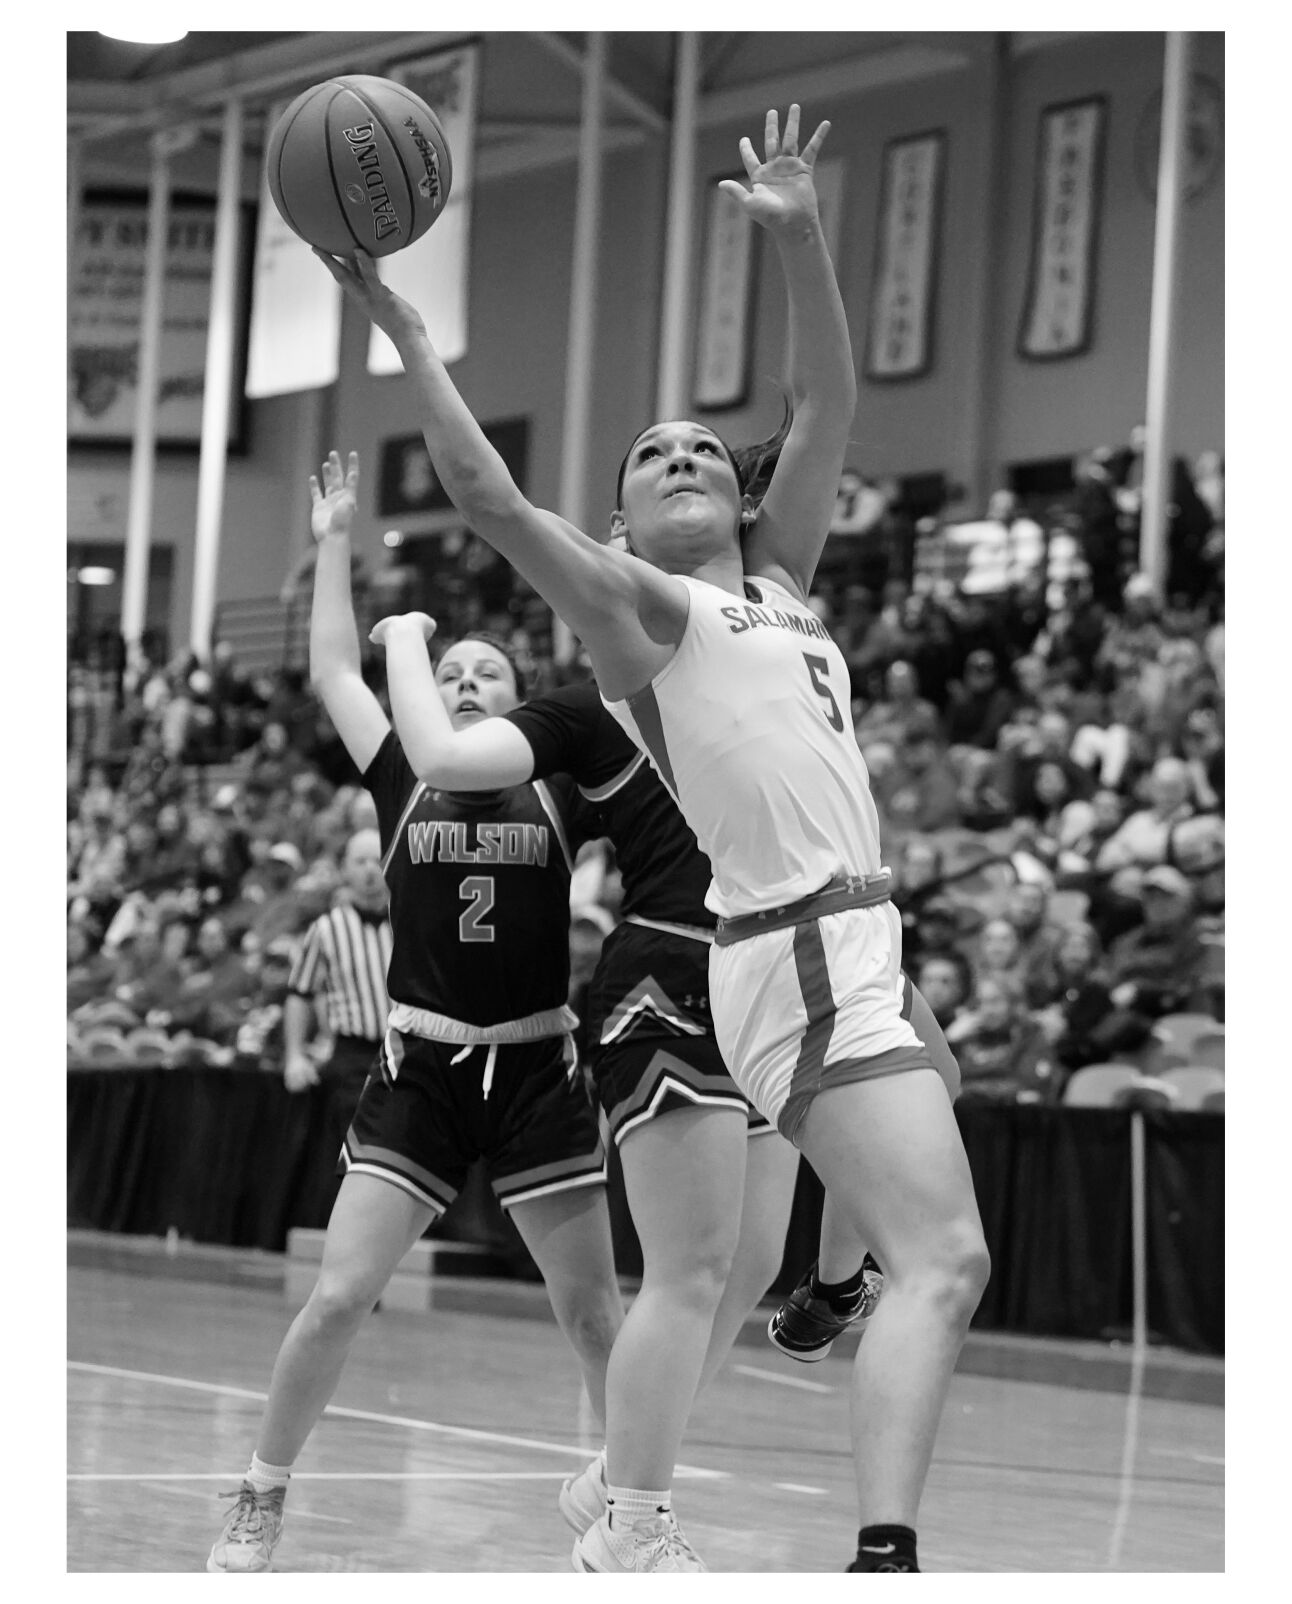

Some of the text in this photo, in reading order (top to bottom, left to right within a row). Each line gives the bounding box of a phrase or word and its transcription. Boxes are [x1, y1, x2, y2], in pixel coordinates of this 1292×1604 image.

[343, 122, 402, 242] SPALDING
[801, 650, 844, 733] 5
[407, 820, 549, 868] WILSON
[459, 875, 495, 943] 2
